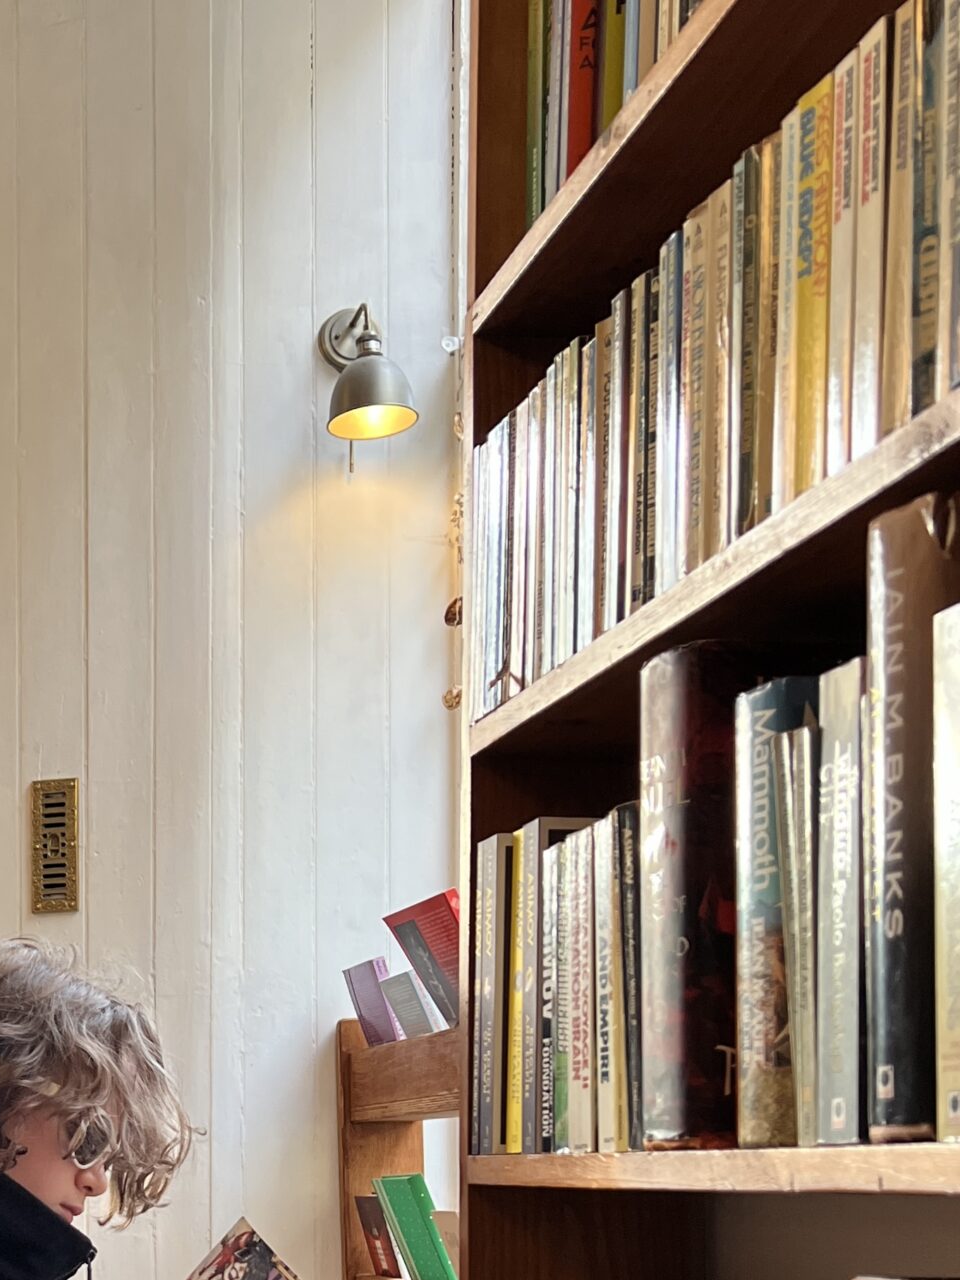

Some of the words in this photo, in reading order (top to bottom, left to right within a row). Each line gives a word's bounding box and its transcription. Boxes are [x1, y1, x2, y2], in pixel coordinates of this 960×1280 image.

[799, 107, 816, 182] BLUE
[797, 187, 814, 280] ADEPT
[635, 473, 644, 499] Poul
[634, 501, 643, 556] Anderson
[885, 567, 905, 675] IAIN
[752, 708, 778, 892] Mammoth
[623, 827, 634, 886] ASIMOV
[474, 888, 482, 958] ASIMOV
[485, 887, 493, 958] ASIMOV
[526, 872, 535, 947] ASIMOV
[751, 916, 767, 972] JEAN
[831, 878, 847, 947] Paolo
[598, 941, 608, 989] AND
[571, 1016, 581, 1081] BRAIN
[581, 986, 590, 1070] VOYAGE
[599, 993, 610, 1085] EMPIRE
[541, 1037, 551, 1138] FOUNDATION
